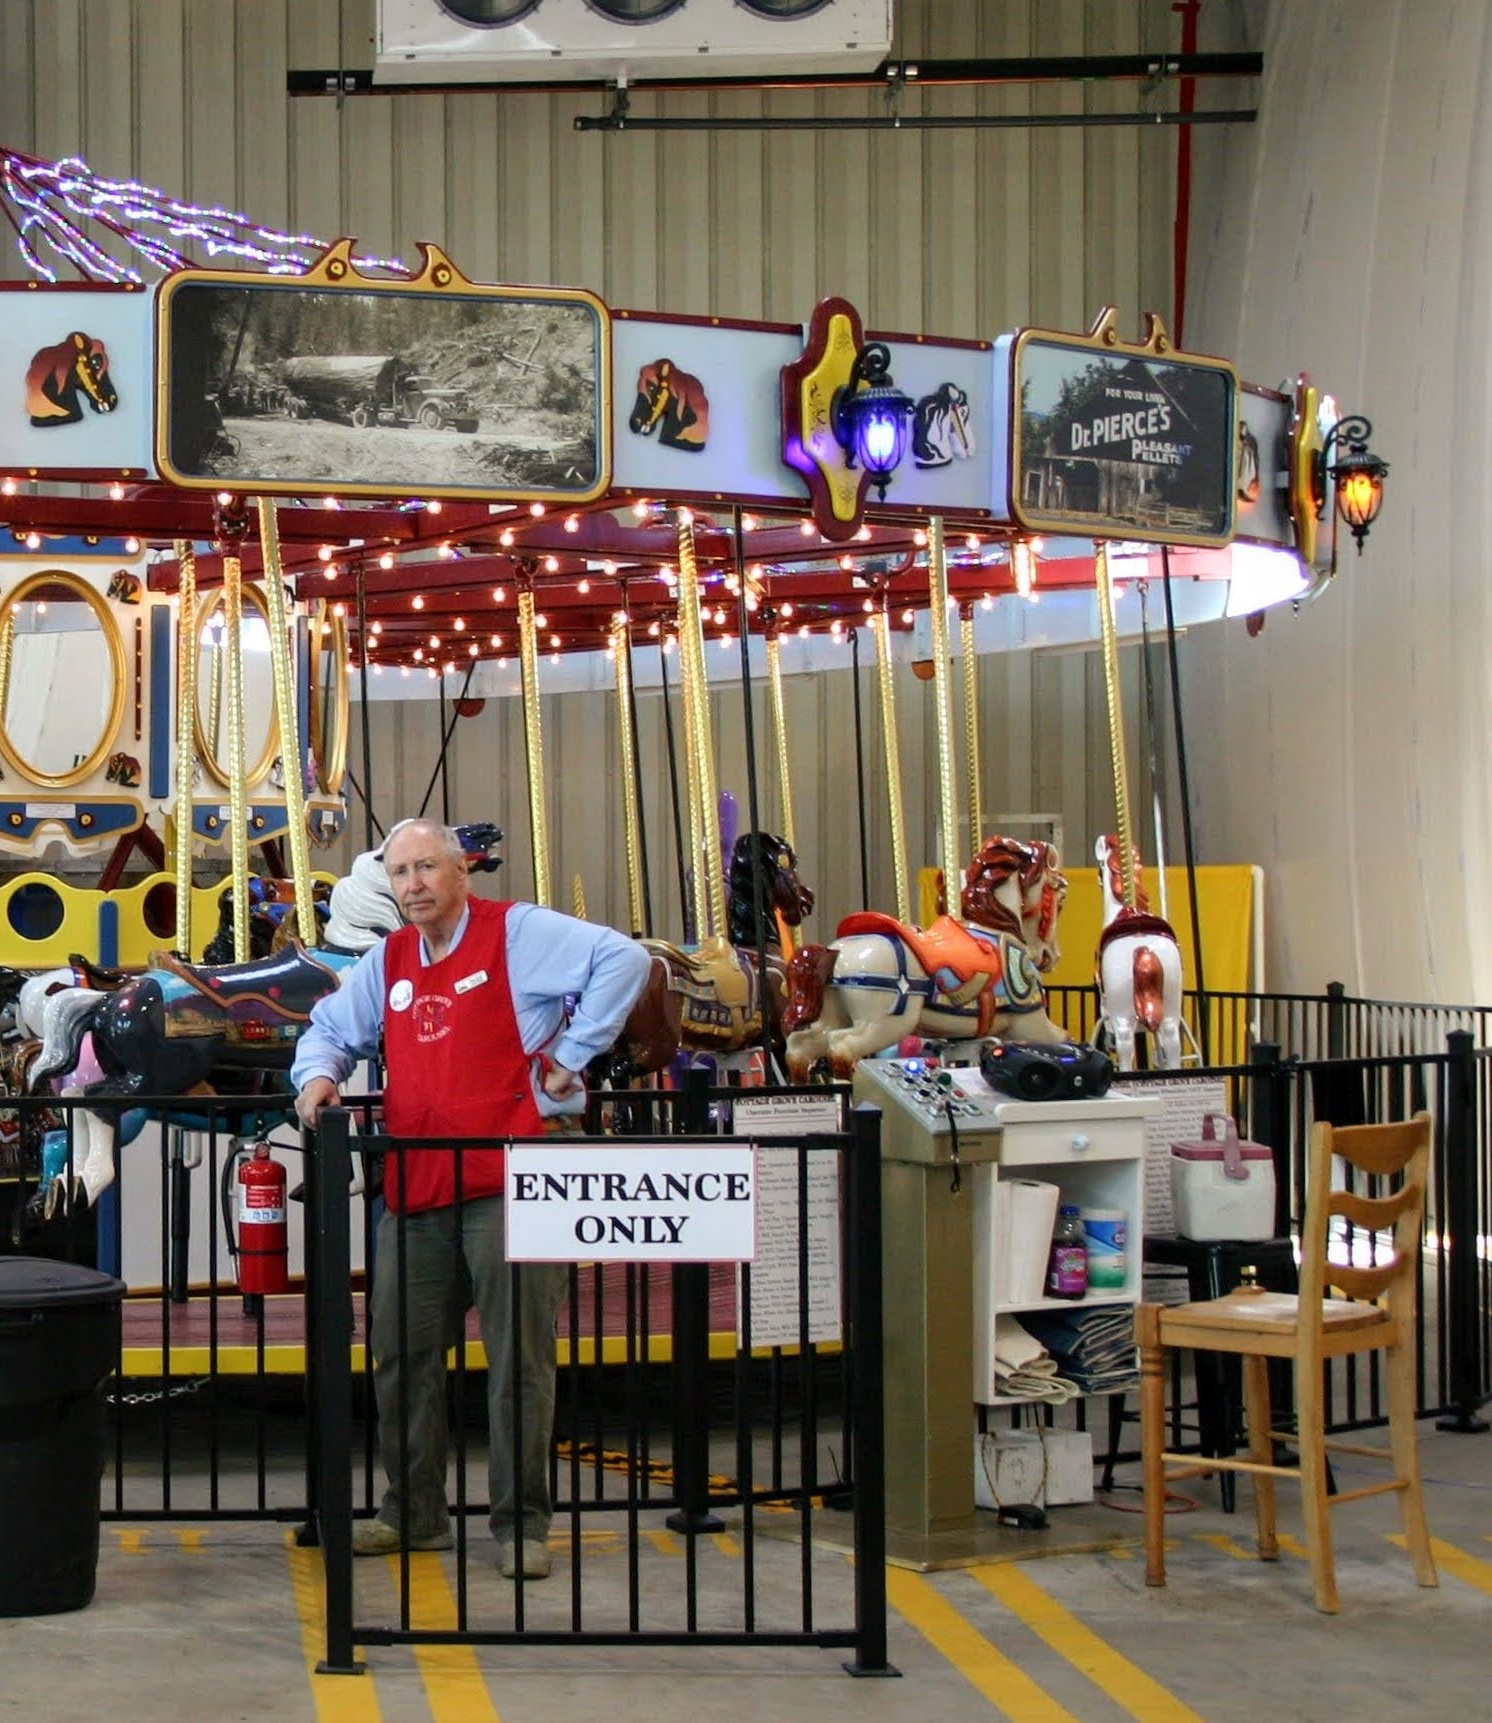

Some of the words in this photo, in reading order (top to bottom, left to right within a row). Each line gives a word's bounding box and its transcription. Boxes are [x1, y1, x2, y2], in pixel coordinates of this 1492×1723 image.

[1106, 387, 1121, 398] FOR
[1123, 389, 1143, 401] YOUR
[1144, 392, 1166, 404] LIVER
[1092, 404, 1171, 446] PIERCE'S
[1131, 439, 1193, 459] PLEASANT
[512, 1172, 750, 1202] ENTRANCE
[574, 1215, 690, 1244] ONLY
